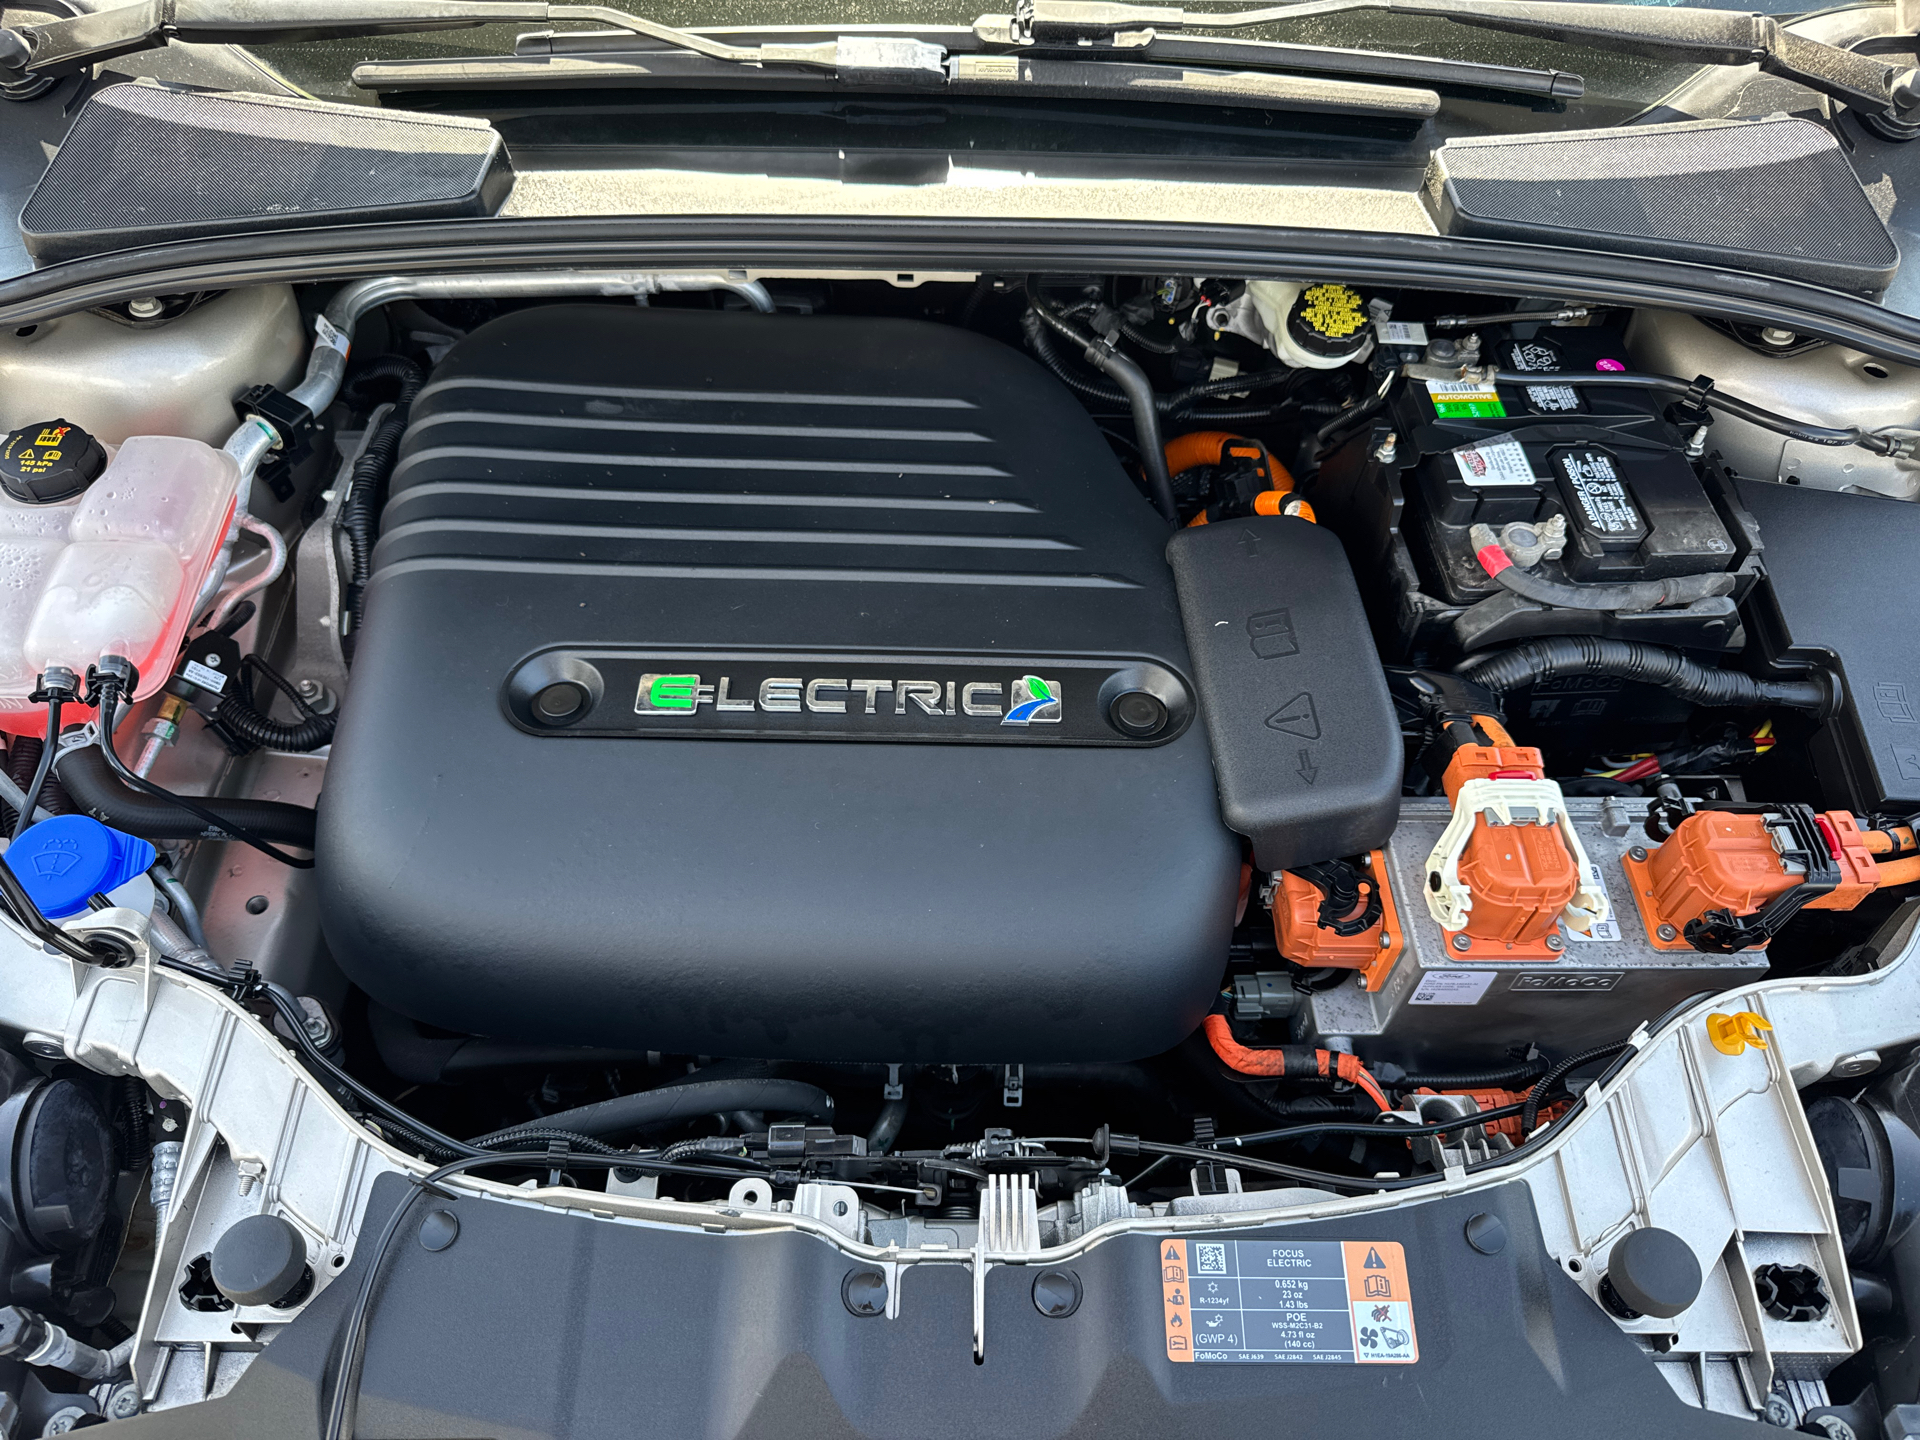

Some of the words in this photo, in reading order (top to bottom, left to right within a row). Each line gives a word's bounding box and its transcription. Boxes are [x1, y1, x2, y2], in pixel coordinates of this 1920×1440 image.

[1561, 458, 1580, 484] POISON
[1576, 491, 1597, 520] DANGER
[1517, 976, 1612, 987] FoMoCo
[1273, 1249, 1304, 1258] FOCUS
[1266, 1258, 1312, 1268] ELECTRIC
[1274, 1280, 1296, 1288] 0.652
[1298, 1280, 1308, 1291] kg
[1282, 1290, 1292, 1299] 23
[1199, 1297, 1229, 1306] R-1234yf
[1279, 1300, 1294, 1308] 1.43
[1296, 1300, 1308, 1308] lbs
[1286, 1312, 1307, 1322] POE
[1280, 1330, 1297, 1338] 4.73
[1298, 1330, 1304, 1338] fl
[1195, 1334, 1225, 1346] (GWP
[1227, 1334, 1238, 1346] 4)
[1284, 1340, 1301, 1348] (140
[1302, 1340, 1315, 1349] cc)
[1194, 1352, 1228, 1360] FoMoCo
